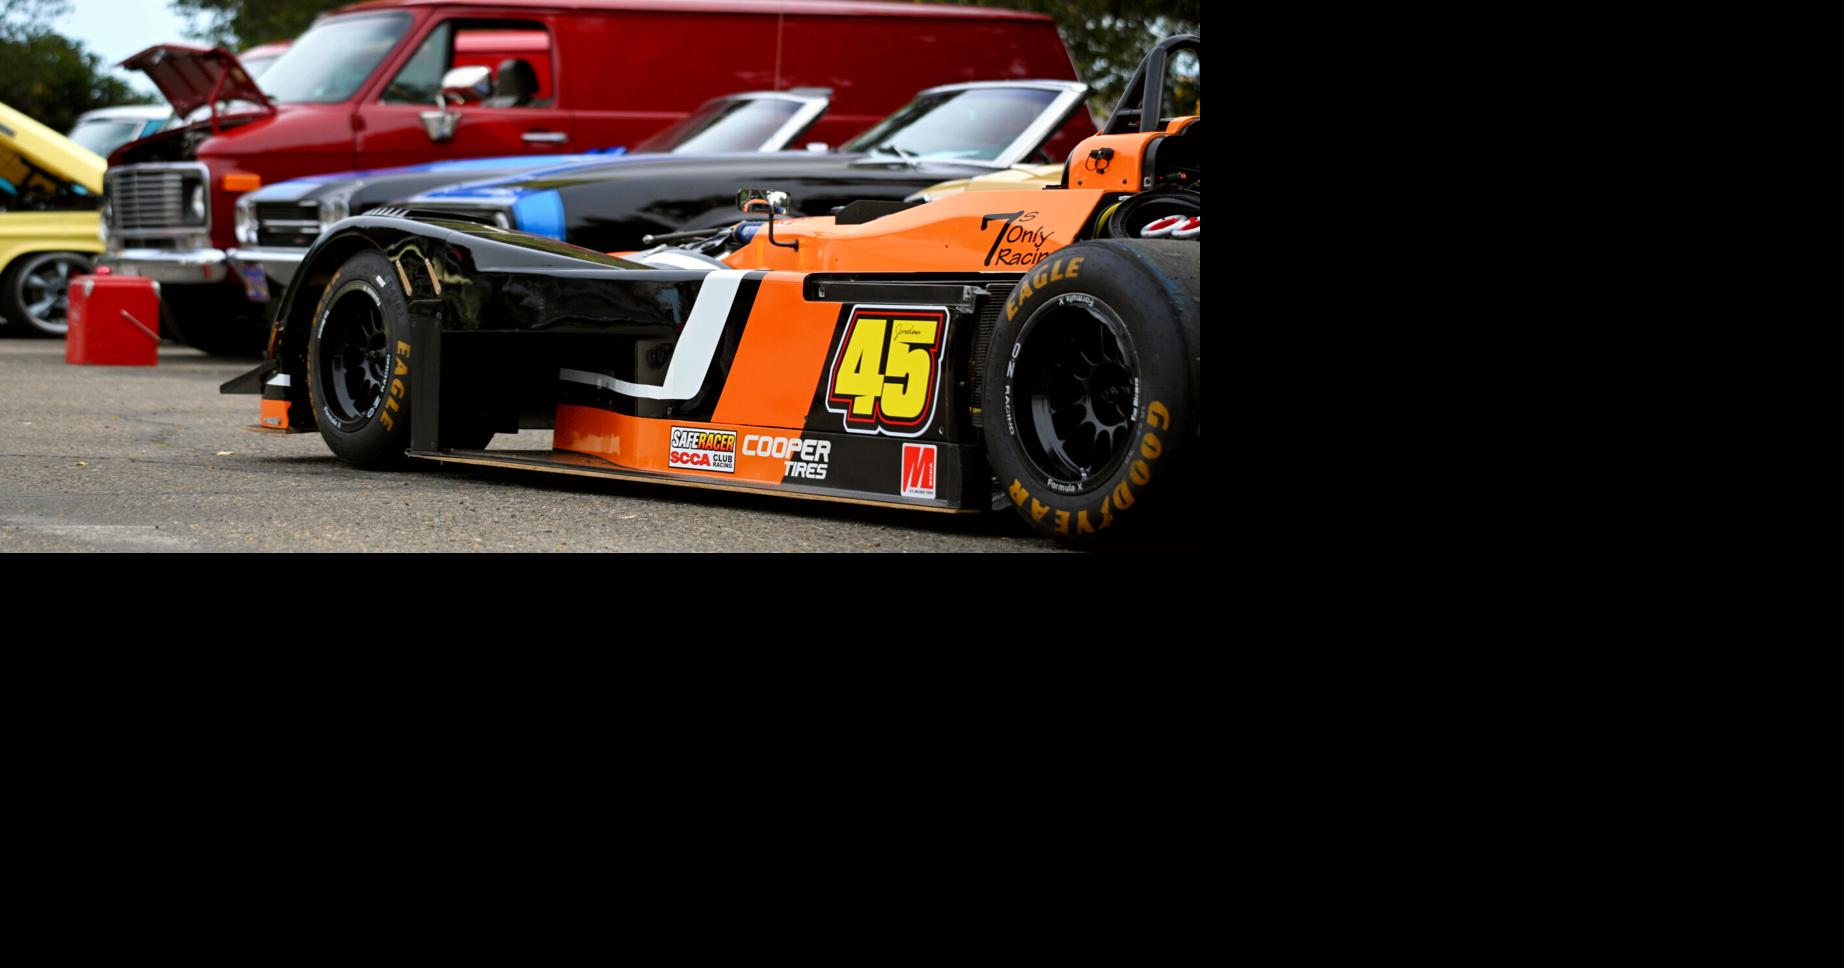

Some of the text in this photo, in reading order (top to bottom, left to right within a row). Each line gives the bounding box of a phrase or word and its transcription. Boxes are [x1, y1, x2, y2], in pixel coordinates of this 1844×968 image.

[1006, 225, 1055, 248] Only
[995, 248, 1049, 265] Racin
[1006, 256, 1085, 321] EAGLE
[834, 319, 938, 418] 45
[379, 340, 411, 432] EAGLE
[1004, 385, 1015, 436] RACING
[671, 429, 735, 453] SAFERACER
[742, 435, 831, 462] COOPER
[670, 451, 711, 467] SCCA
[713, 454, 733, 463] CLUB
[783, 460, 828, 480] TIRES
[1047, 478, 1083, 492] Formula X
